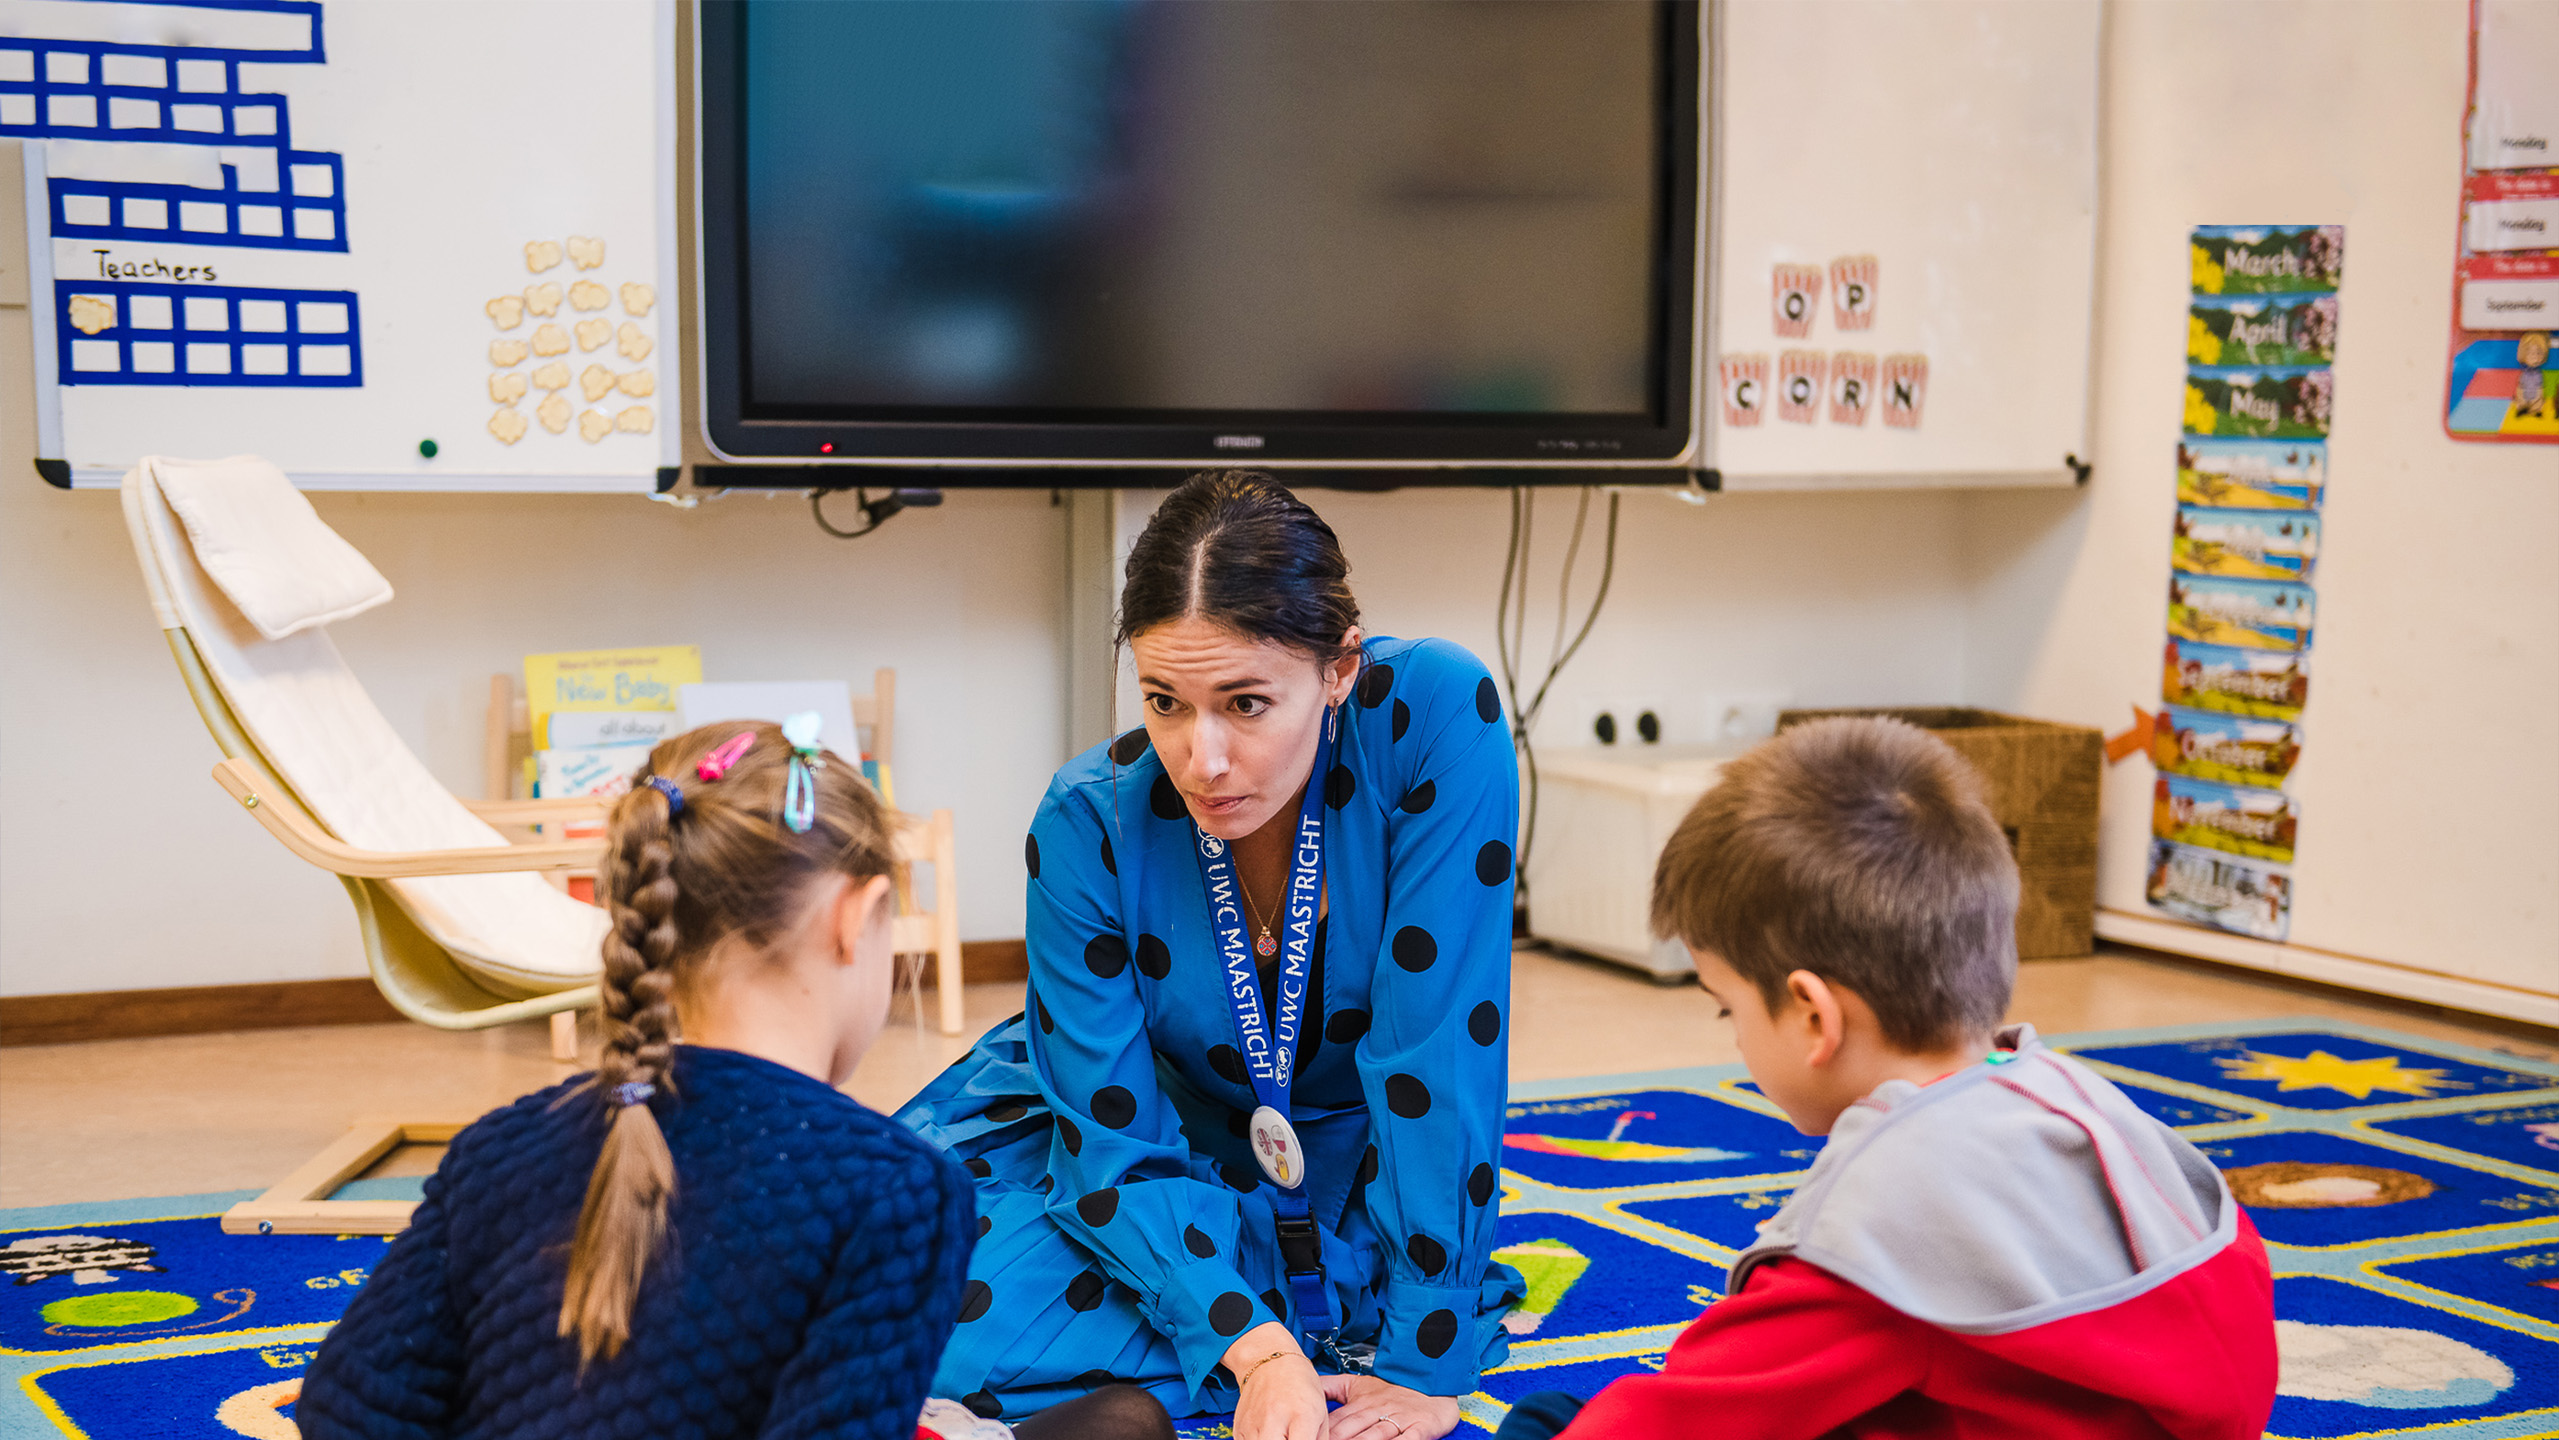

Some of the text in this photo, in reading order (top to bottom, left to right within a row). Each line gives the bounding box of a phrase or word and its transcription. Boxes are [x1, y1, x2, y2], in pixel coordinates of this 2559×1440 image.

[92, 249, 216, 281] Teachers
[2224, 246, 2300, 277] March
[2229, 313, 2288, 364] April
[2230, 389, 2280, 431] May
[556, 672, 671, 706] New Baby
[1279, 814, 1321, 1042] UWC MAASTRICHT
[1207, 862, 1274, 1080] UWC MAASTRICHT
